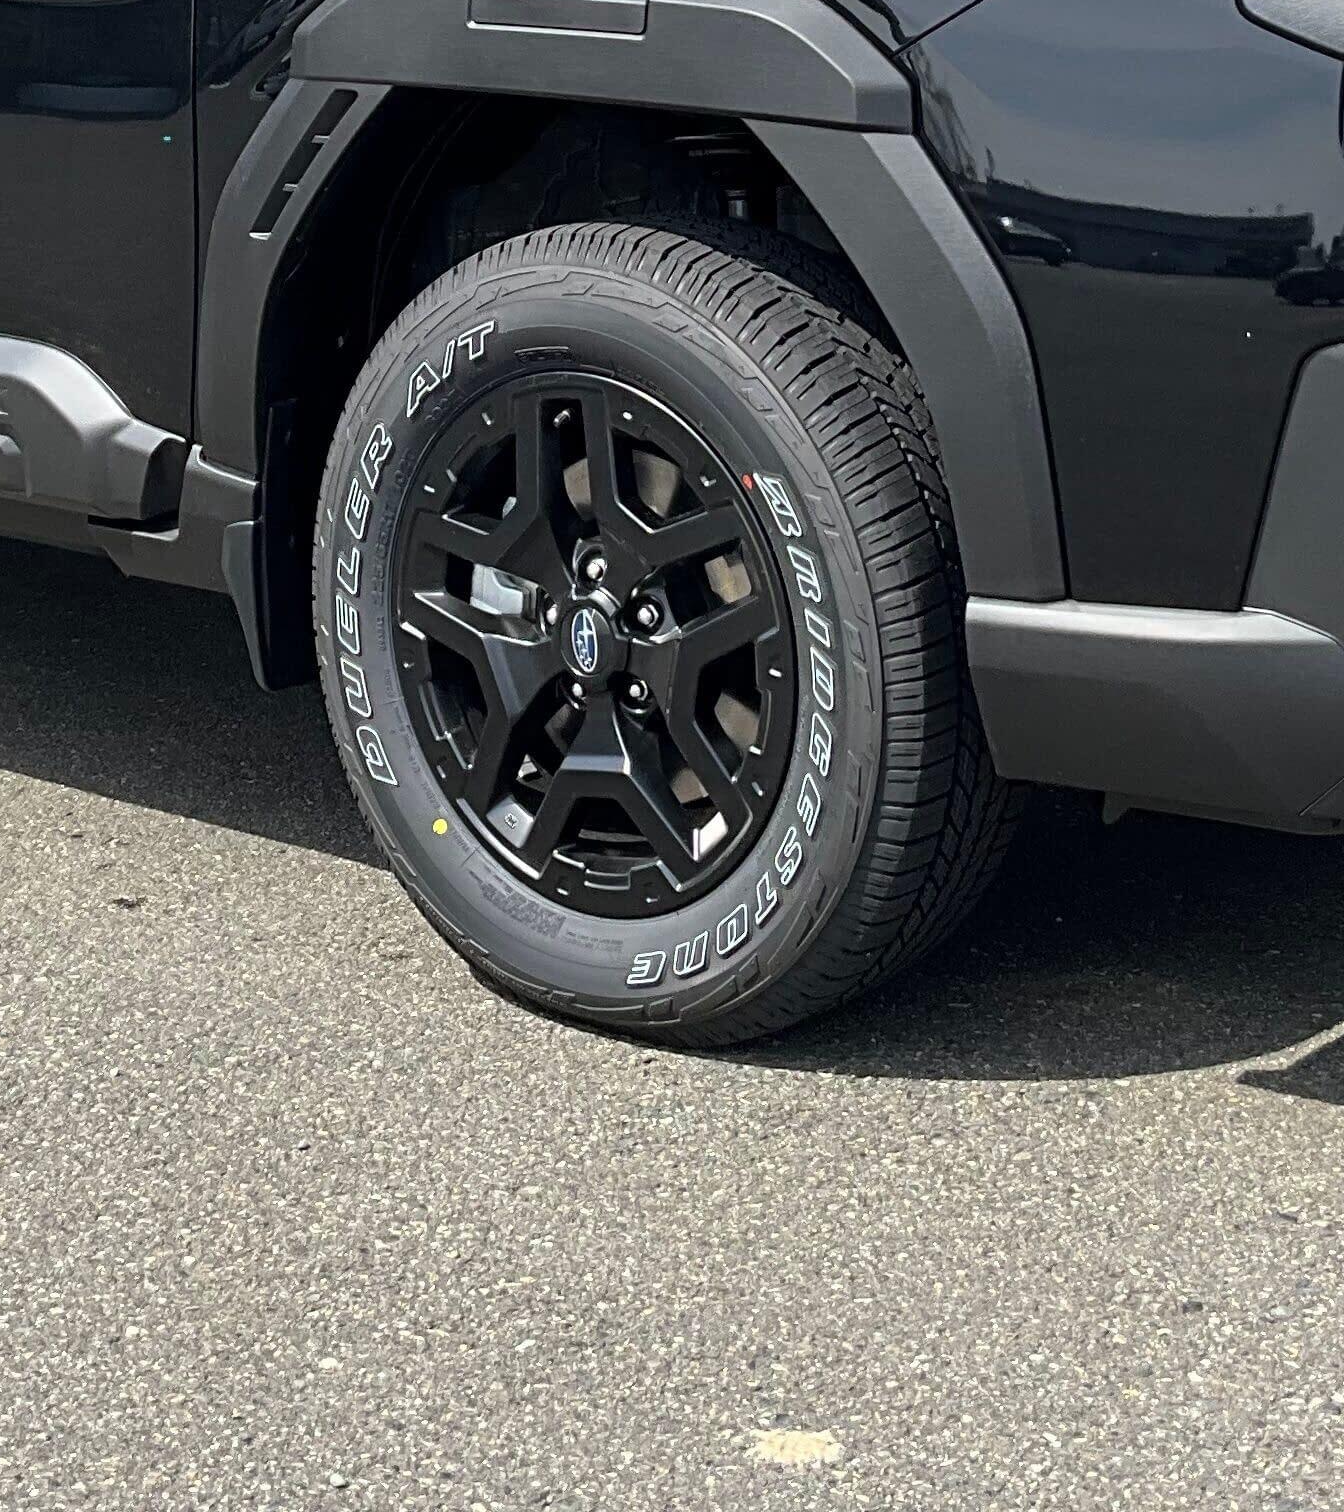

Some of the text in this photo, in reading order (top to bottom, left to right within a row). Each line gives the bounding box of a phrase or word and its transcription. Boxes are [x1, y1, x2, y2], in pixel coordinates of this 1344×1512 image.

[334, 421, 398, 786] DUELER
[406, 319, 496, 418] A/T
[626, 472, 836, 985] BRIDGESTONE
